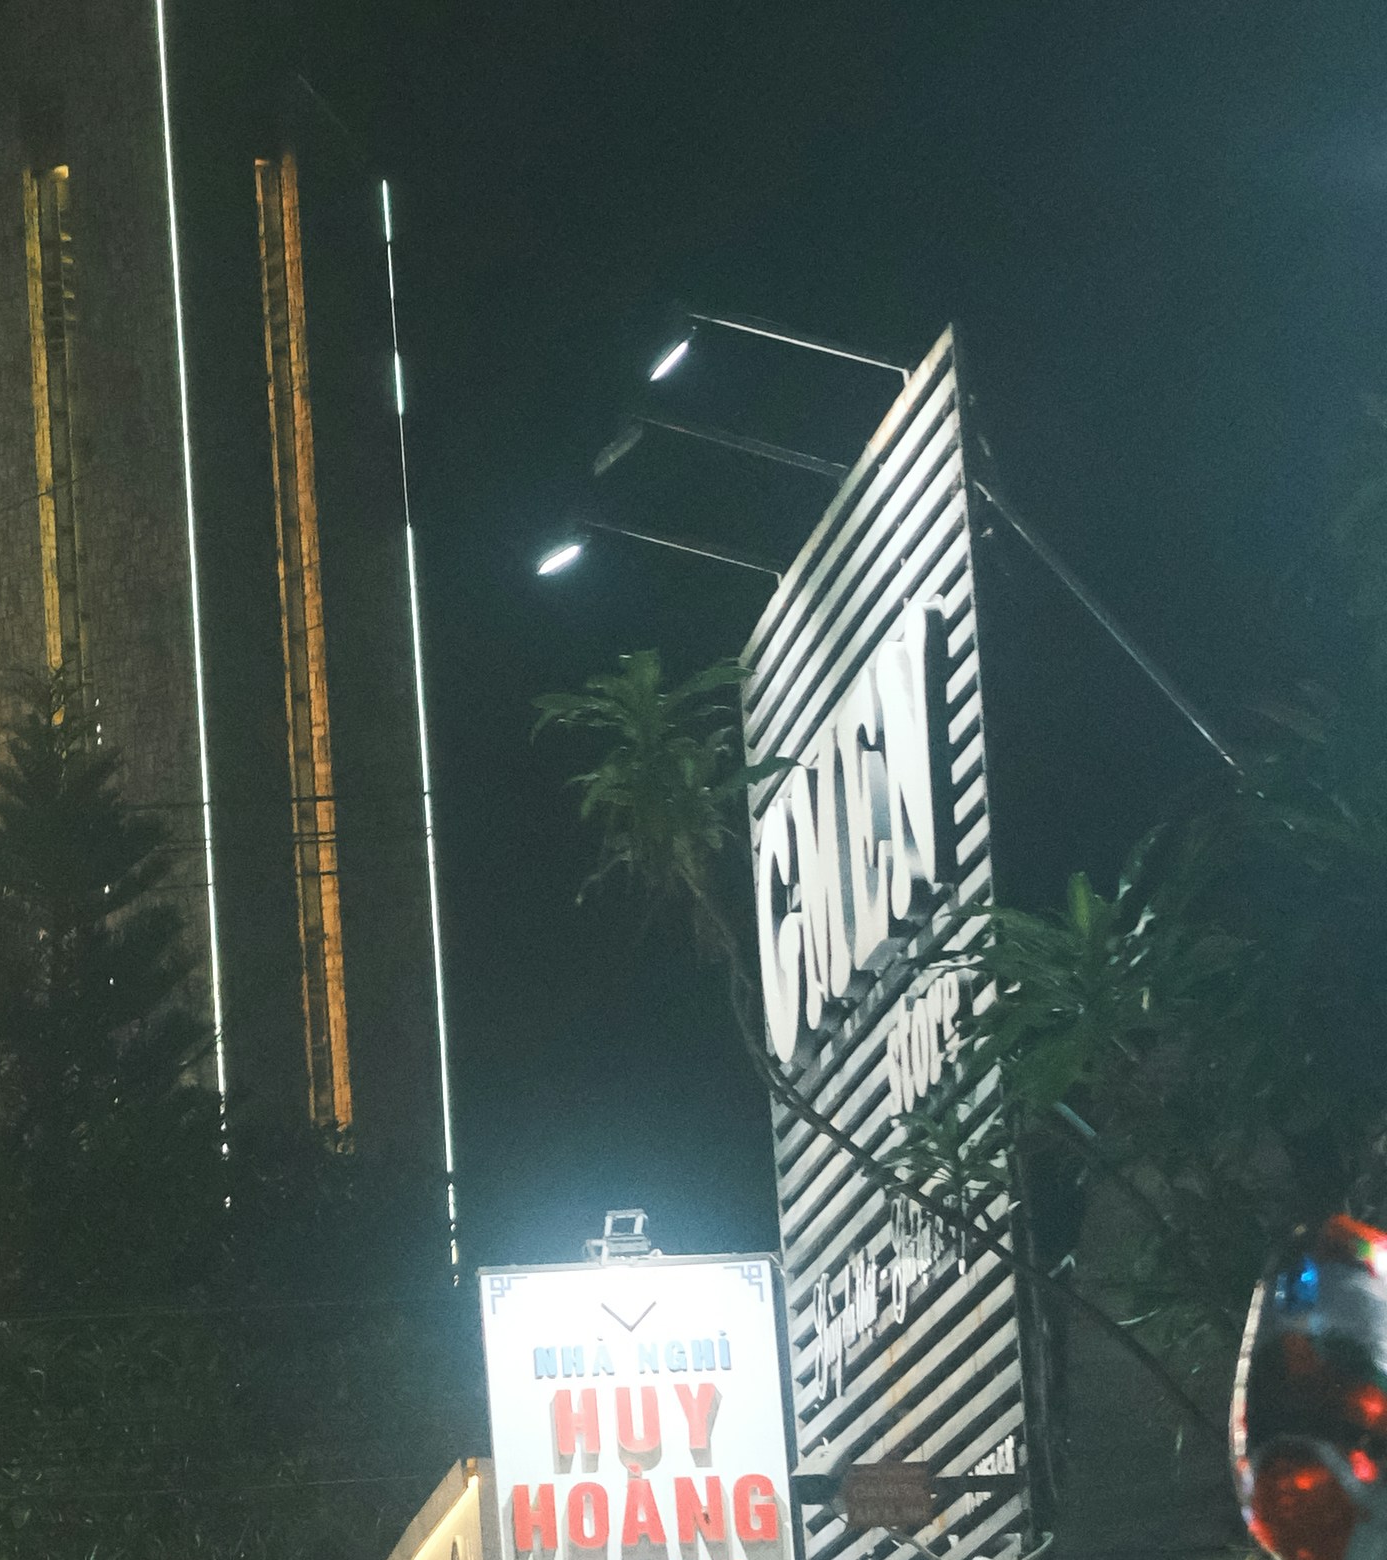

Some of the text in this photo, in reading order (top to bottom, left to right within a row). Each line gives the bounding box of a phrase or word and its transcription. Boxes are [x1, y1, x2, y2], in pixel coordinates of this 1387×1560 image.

[758, 594, 945, 1063] GMEN
[533, 1336, 615, 1379] NHÀ
[552, 1383, 719, 1459] HUY
[509, 1463, 780, 1554] HOÀNG
